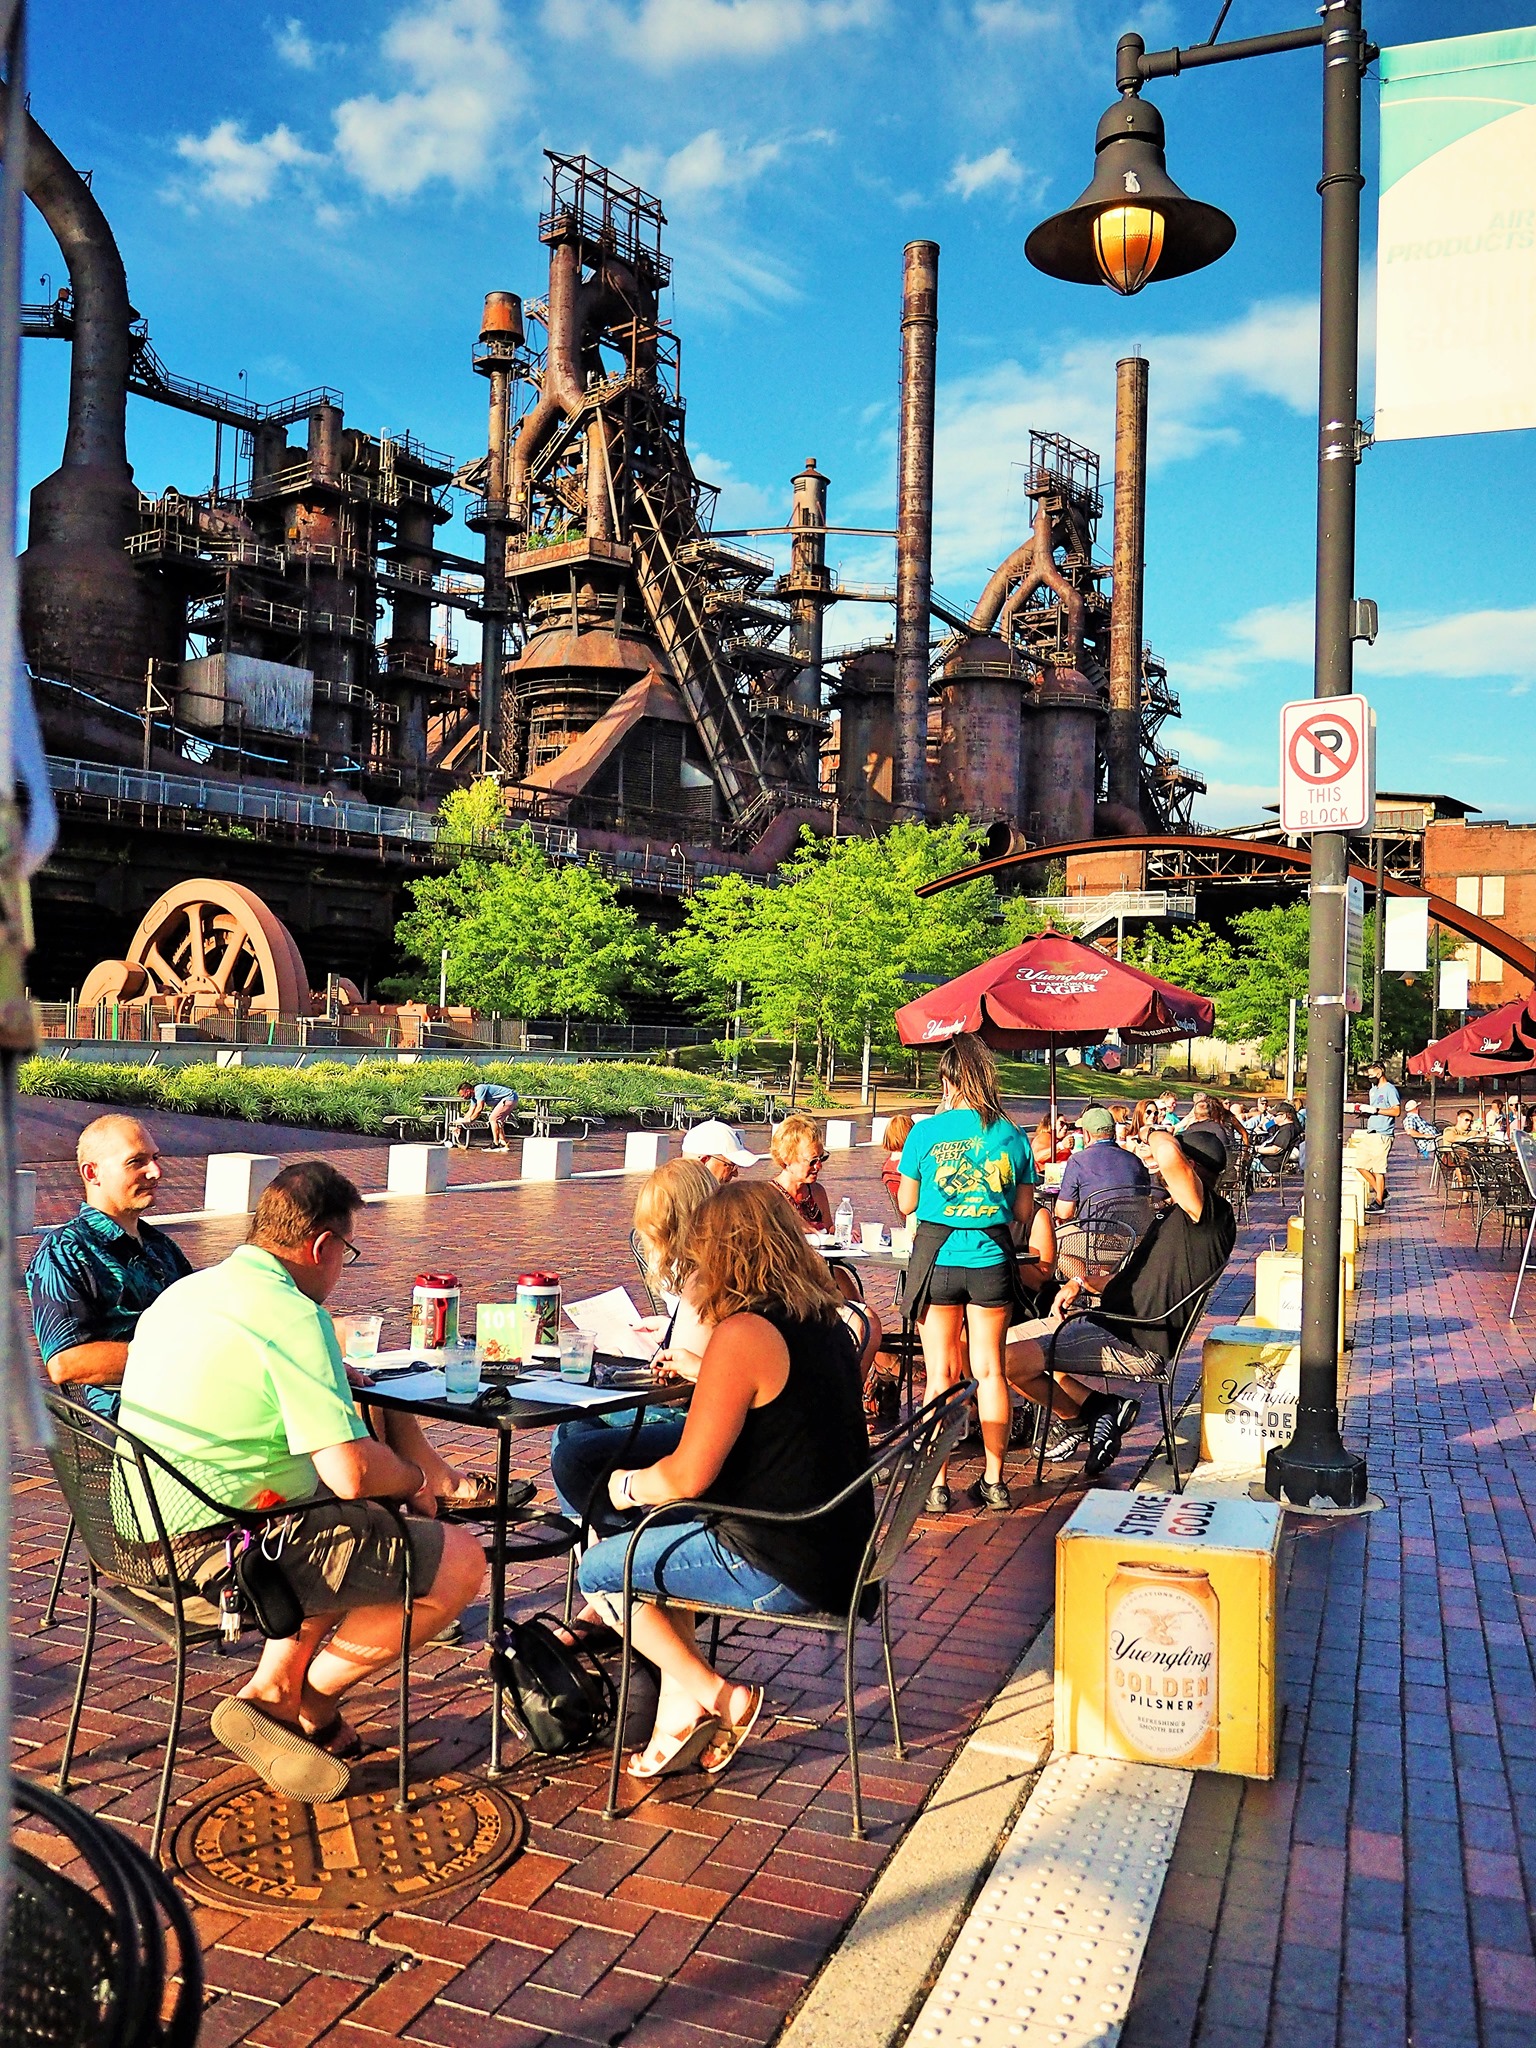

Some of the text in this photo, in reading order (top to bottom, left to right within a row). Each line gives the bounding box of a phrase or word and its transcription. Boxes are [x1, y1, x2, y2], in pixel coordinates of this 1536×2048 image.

[1489, 209, 1535, 230] AIR
[1386, 231, 1534, 264] PRODUCTS
[1308, 787, 1341, 804] THIS
[1300, 807, 1348, 825] BLOCK
[1016, 967, 1109, 983] Yuengling
[1030, 984, 1097, 995] LAGER
[932, 1140, 971, 1154] MUSIK
[937, 1150, 963, 1162] FEST
[943, 1204, 1000, 1218] STAFF
[481, 1310, 516, 1329] 101
[1225, 1408, 1292, 1428] GOLDE
[1240, 1427, 1292, 1440] PILSNER
[1113, 1495, 1172, 1536] STRIKE
[1110, 1630, 1214, 1672] Yuengling
[1114, 1666, 1210, 1699] GOLDEN
[1130, 1694, 1194, 1711] PILSNER
[1137, 1716, 1179, 1727] REFRESHING
[1139, 1723, 1166, 1733] SMOOTH
